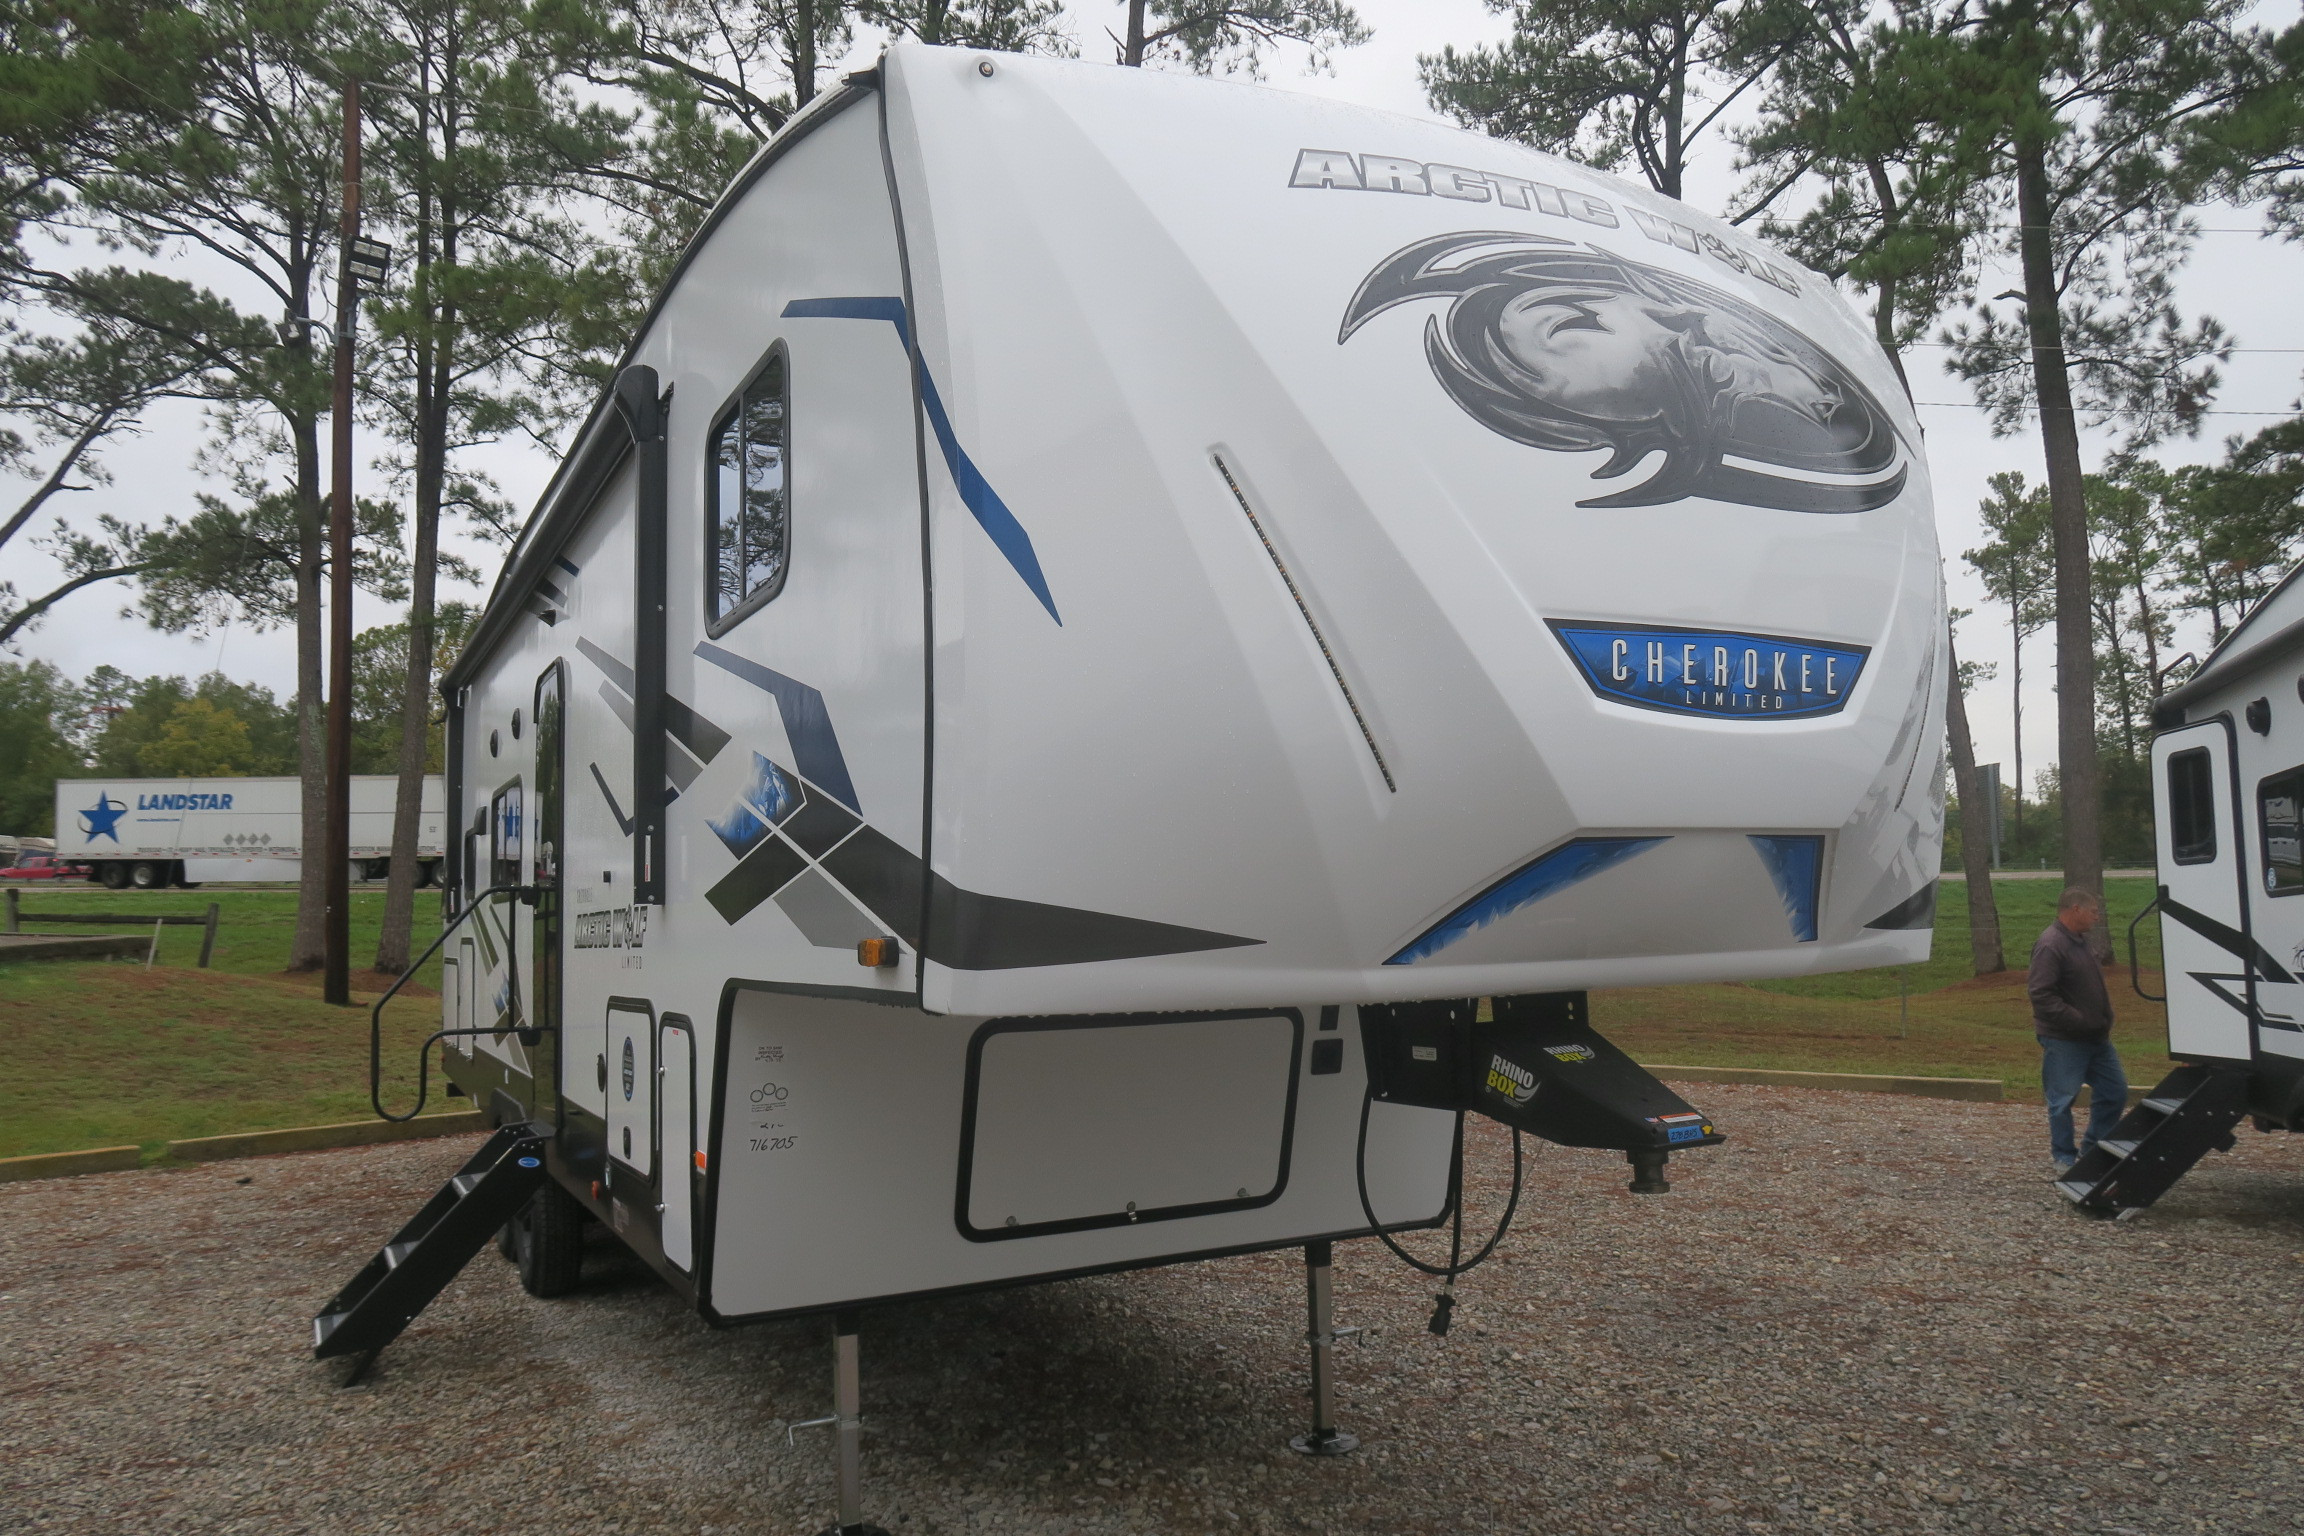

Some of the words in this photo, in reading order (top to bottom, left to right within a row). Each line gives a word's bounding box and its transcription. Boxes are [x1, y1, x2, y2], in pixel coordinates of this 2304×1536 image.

[1288, 148, 1620, 229] ARCTIC
[1612, 639, 1838, 695] CHEROKEE
[1685, 690, 1783, 710] LIMITED
[137, 793, 233, 811] LANDSTAR
[1543, 1044, 1586, 1056] RHINO
[1552, 1052, 1588, 1062] BOX
[1491, 1054, 1534, 1088] RHINO
[1487, 1069, 1518, 1098] BOX
[750, 1136, 798, 1151] 716705
